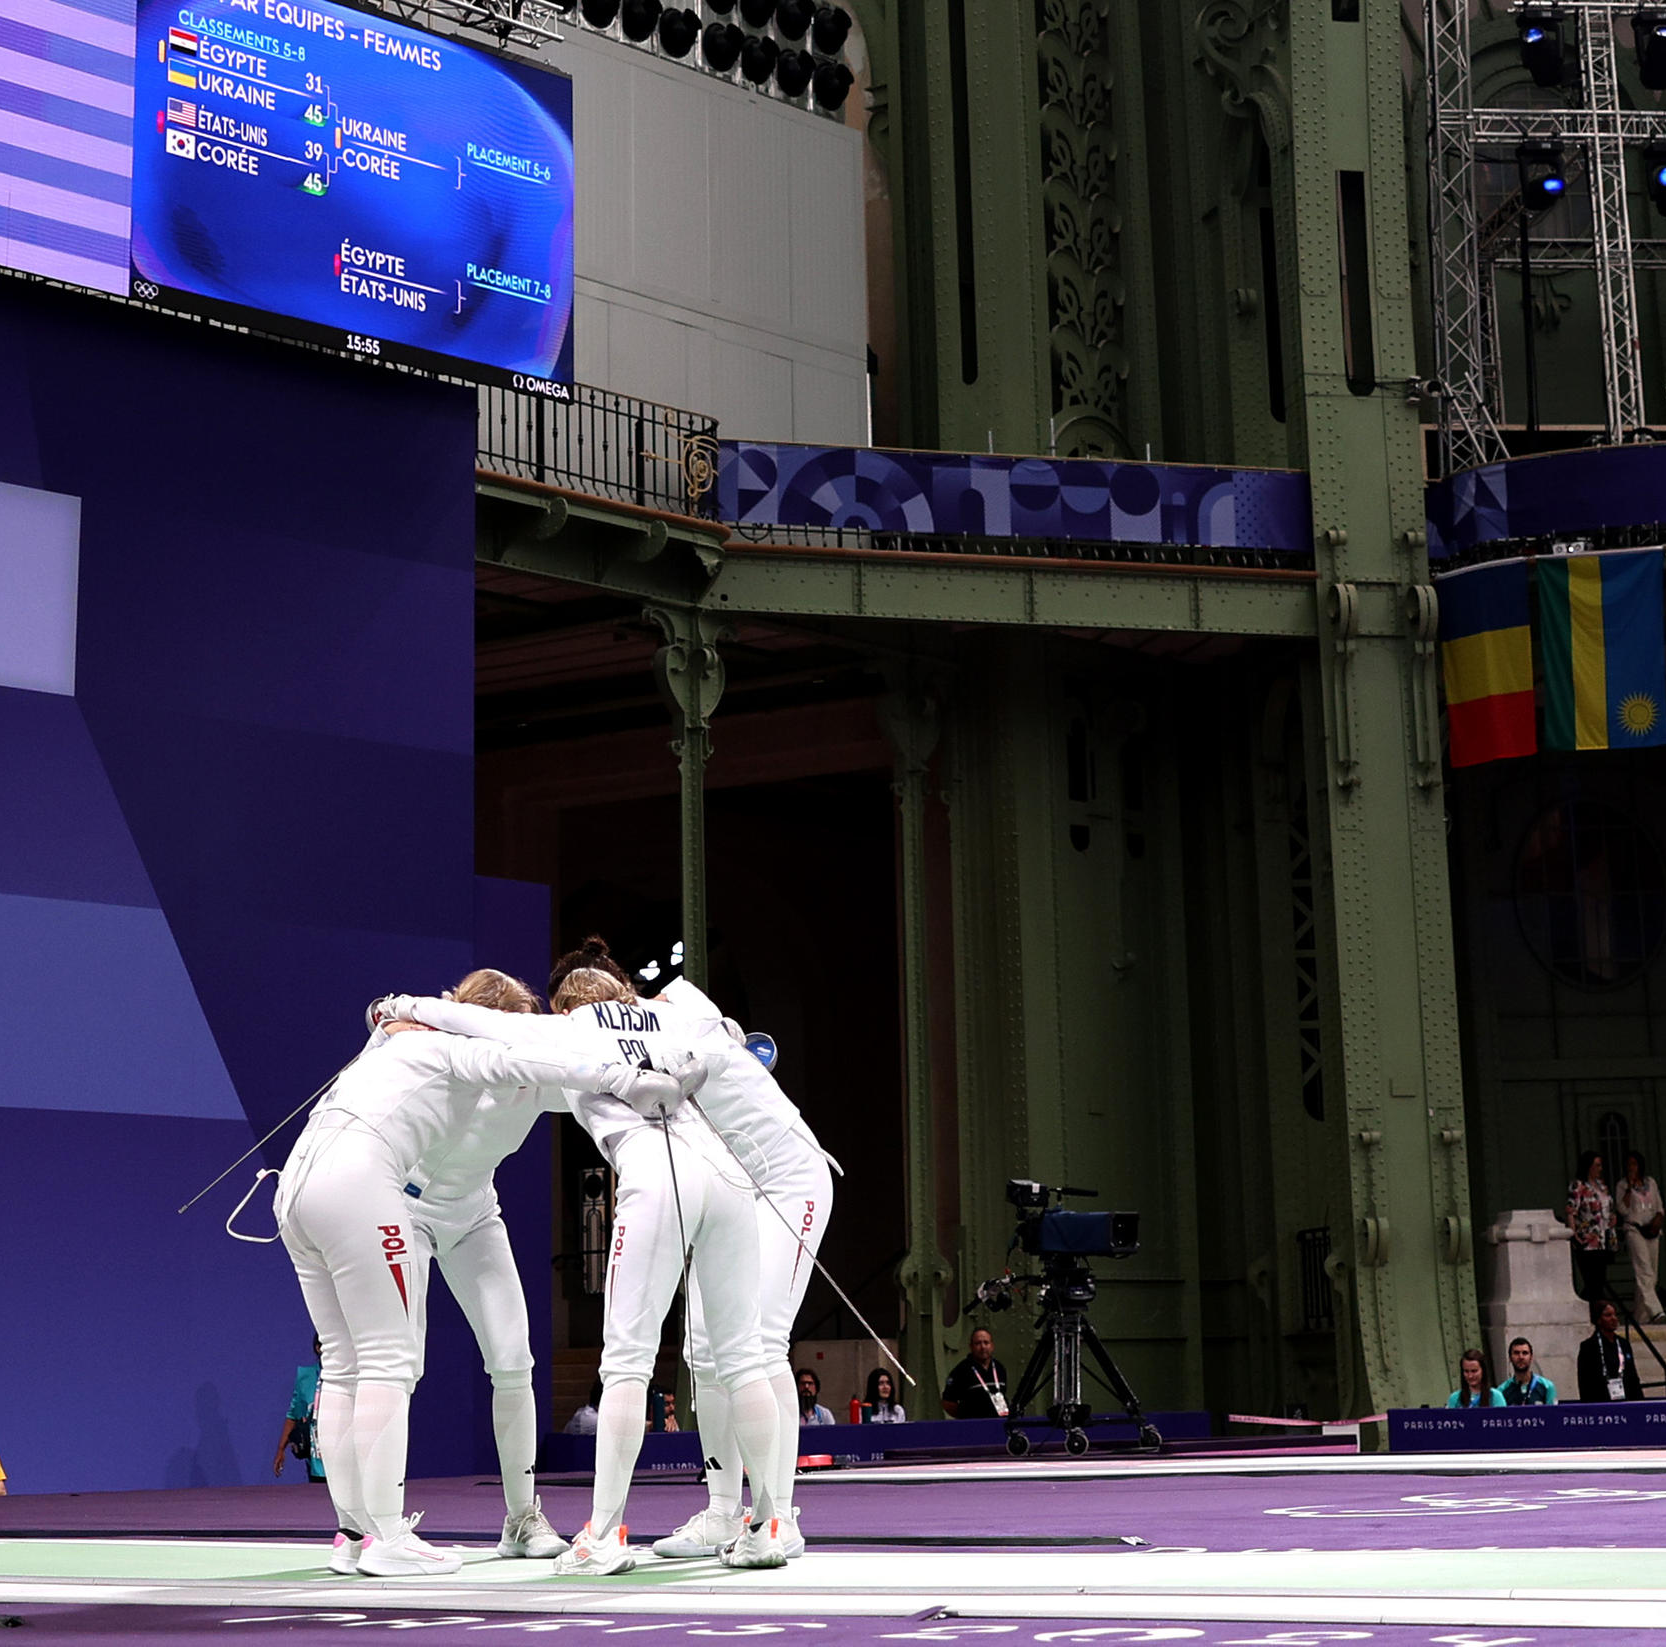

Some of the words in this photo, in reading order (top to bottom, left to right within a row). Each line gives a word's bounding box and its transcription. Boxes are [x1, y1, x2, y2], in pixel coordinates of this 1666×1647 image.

[178, 9, 280, 54] CLASSEMENTS
[282, 41, 306, 62] 5-8
[363, 28, 442, 71] FEMMES
[199, 36, 267, 79] ÉGYPTE
[305, 72, 323, 94] 31
[198, 70, 276, 110] UKRAINE
[304, 104, 323, 124] 45
[198, 105, 268, 147] ÉTATS-UNIS
[305, 140, 323, 161] 39
[342, 116, 407, 152] UKRAINE
[196, 141, 259, 176] CORÉE
[303, 173, 323, 193] 45
[342, 148, 400, 181] CORÉE
[466, 142, 531, 176] PLACEMENT
[533, 162, 551, 181] 5-6
[341, 238, 405, 278] ÉGYPTE
[340, 268, 426, 312] ÉTATS-UNIS
[466, 262, 531, 296] PLACEMENT
[533, 283, 552, 300] 7-8
[346, 334, 381, 362] 15:55
[526, 377, 570, 400] OMEGA
[801, 1200, 814, 1236] POL
[377, 1225, 408, 1261] POL
[613, 1226, 626, 1261] POL
[1437, 1421, 1465, 1430] 2024
[1517, 1418, 1545, 1427] 2024
[1598, 1415, 1627, 1424] 2024
